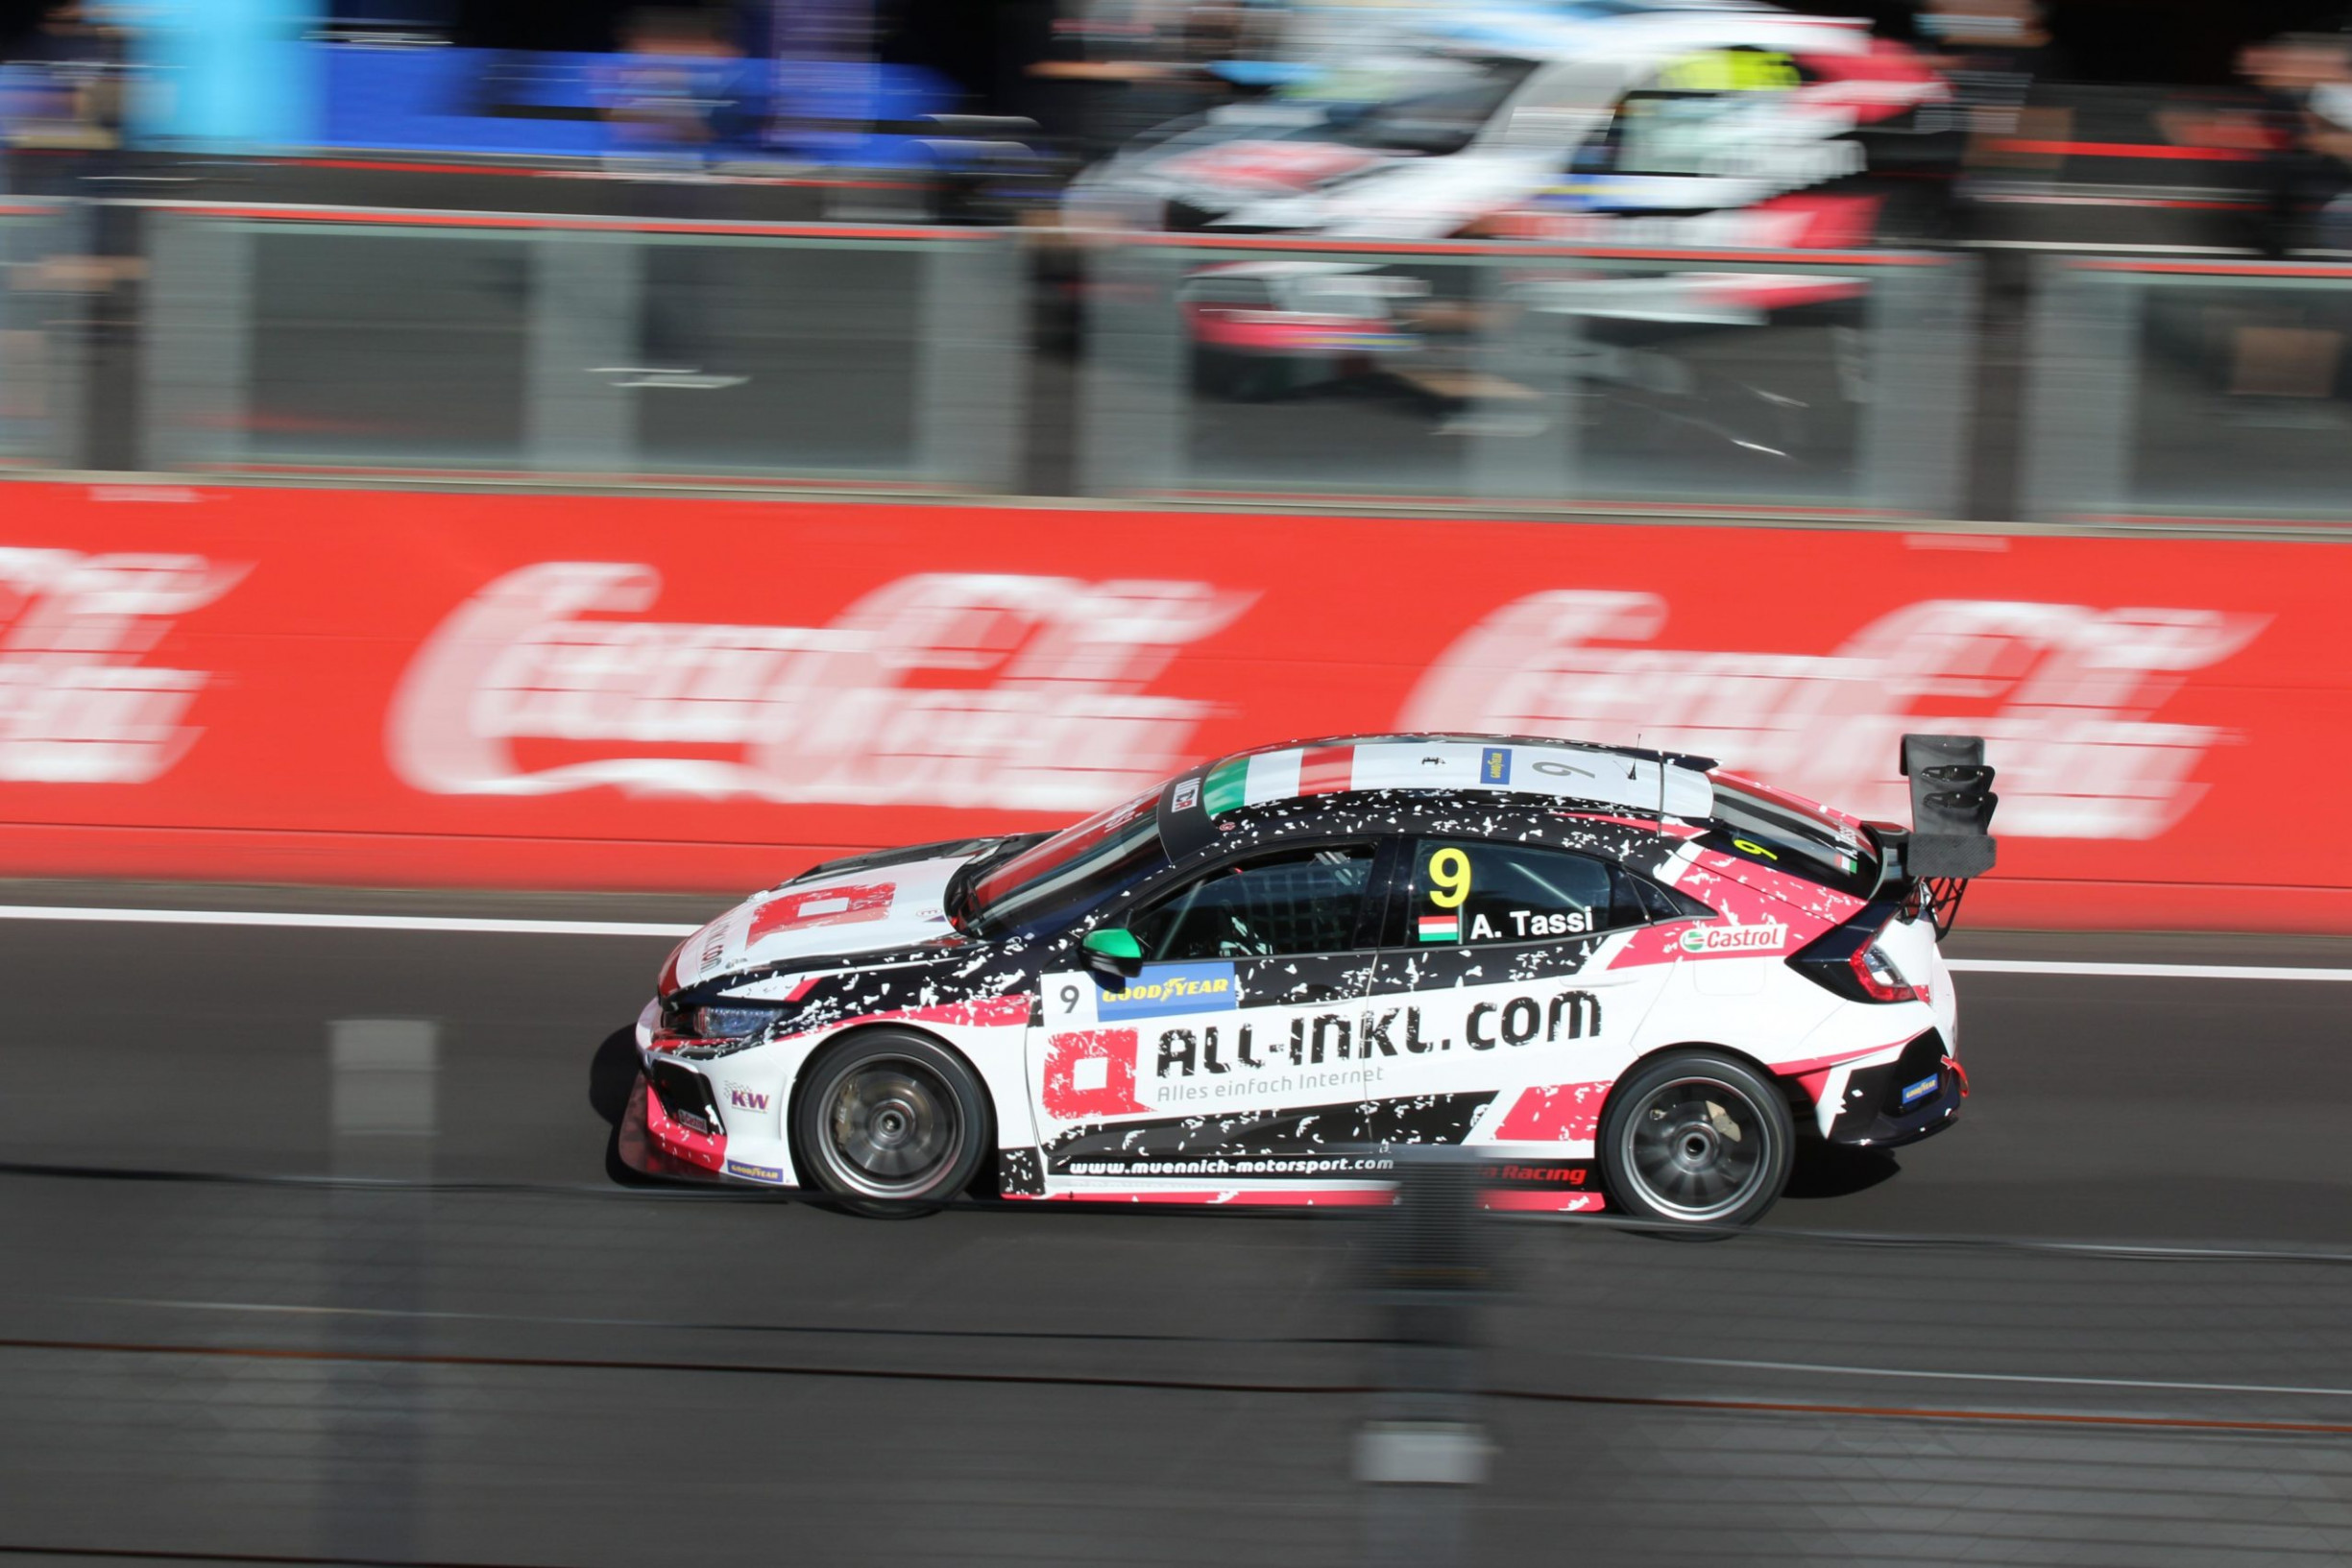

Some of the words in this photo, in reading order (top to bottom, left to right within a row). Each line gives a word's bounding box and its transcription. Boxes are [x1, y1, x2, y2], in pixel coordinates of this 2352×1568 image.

[1734, 839, 1778, 860] 9
[1429, 848, 1471, 908] 9
[1470, 914, 1502, 940] A.
[1510, 905, 1593, 937] Tassi
[1707, 929, 1779, 949] Castrol
[1059, 984, 1080, 1014] 9
[1103, 977, 1229, 1003] GOODYEAR
[1157, 1085, 1208, 1102] Alles
[1215, 1076, 1293, 1098] einfach
[1298, 1066, 1384, 1089] Internet
[731, 1090, 769, 1110] KW
[1070, 1158, 1394, 1175] www.muennich-motorsport.com
[1501, 1165, 1587, 1185] Racing
